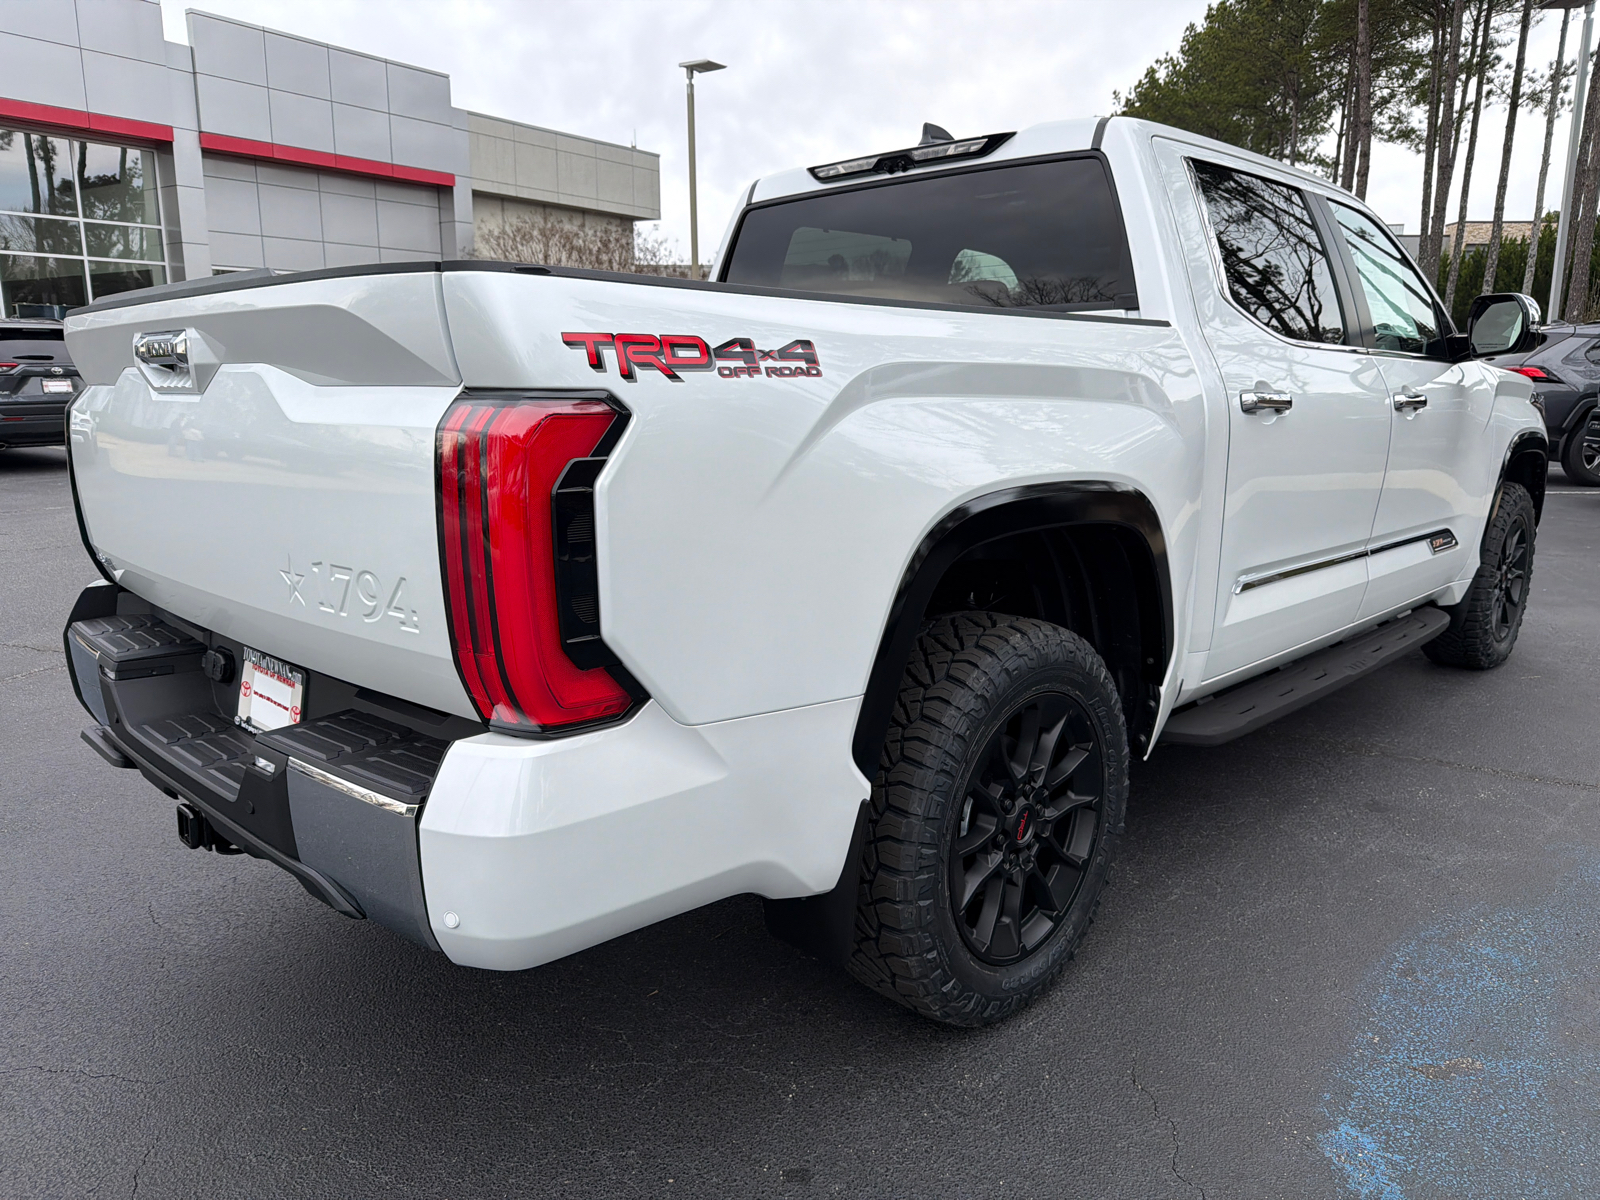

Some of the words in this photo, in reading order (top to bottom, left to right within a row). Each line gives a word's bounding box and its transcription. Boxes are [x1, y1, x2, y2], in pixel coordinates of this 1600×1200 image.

[561, 332, 716, 382] TRD
[714, 338, 820, 367] 4x4
[717, 366, 762, 378] OFF
[765, 366, 822, 378] ROAD
[311, 561, 420, 634] 1794
[252, 664, 269, 677] TOYOTA
[1016, 810, 1029, 841] TRD
